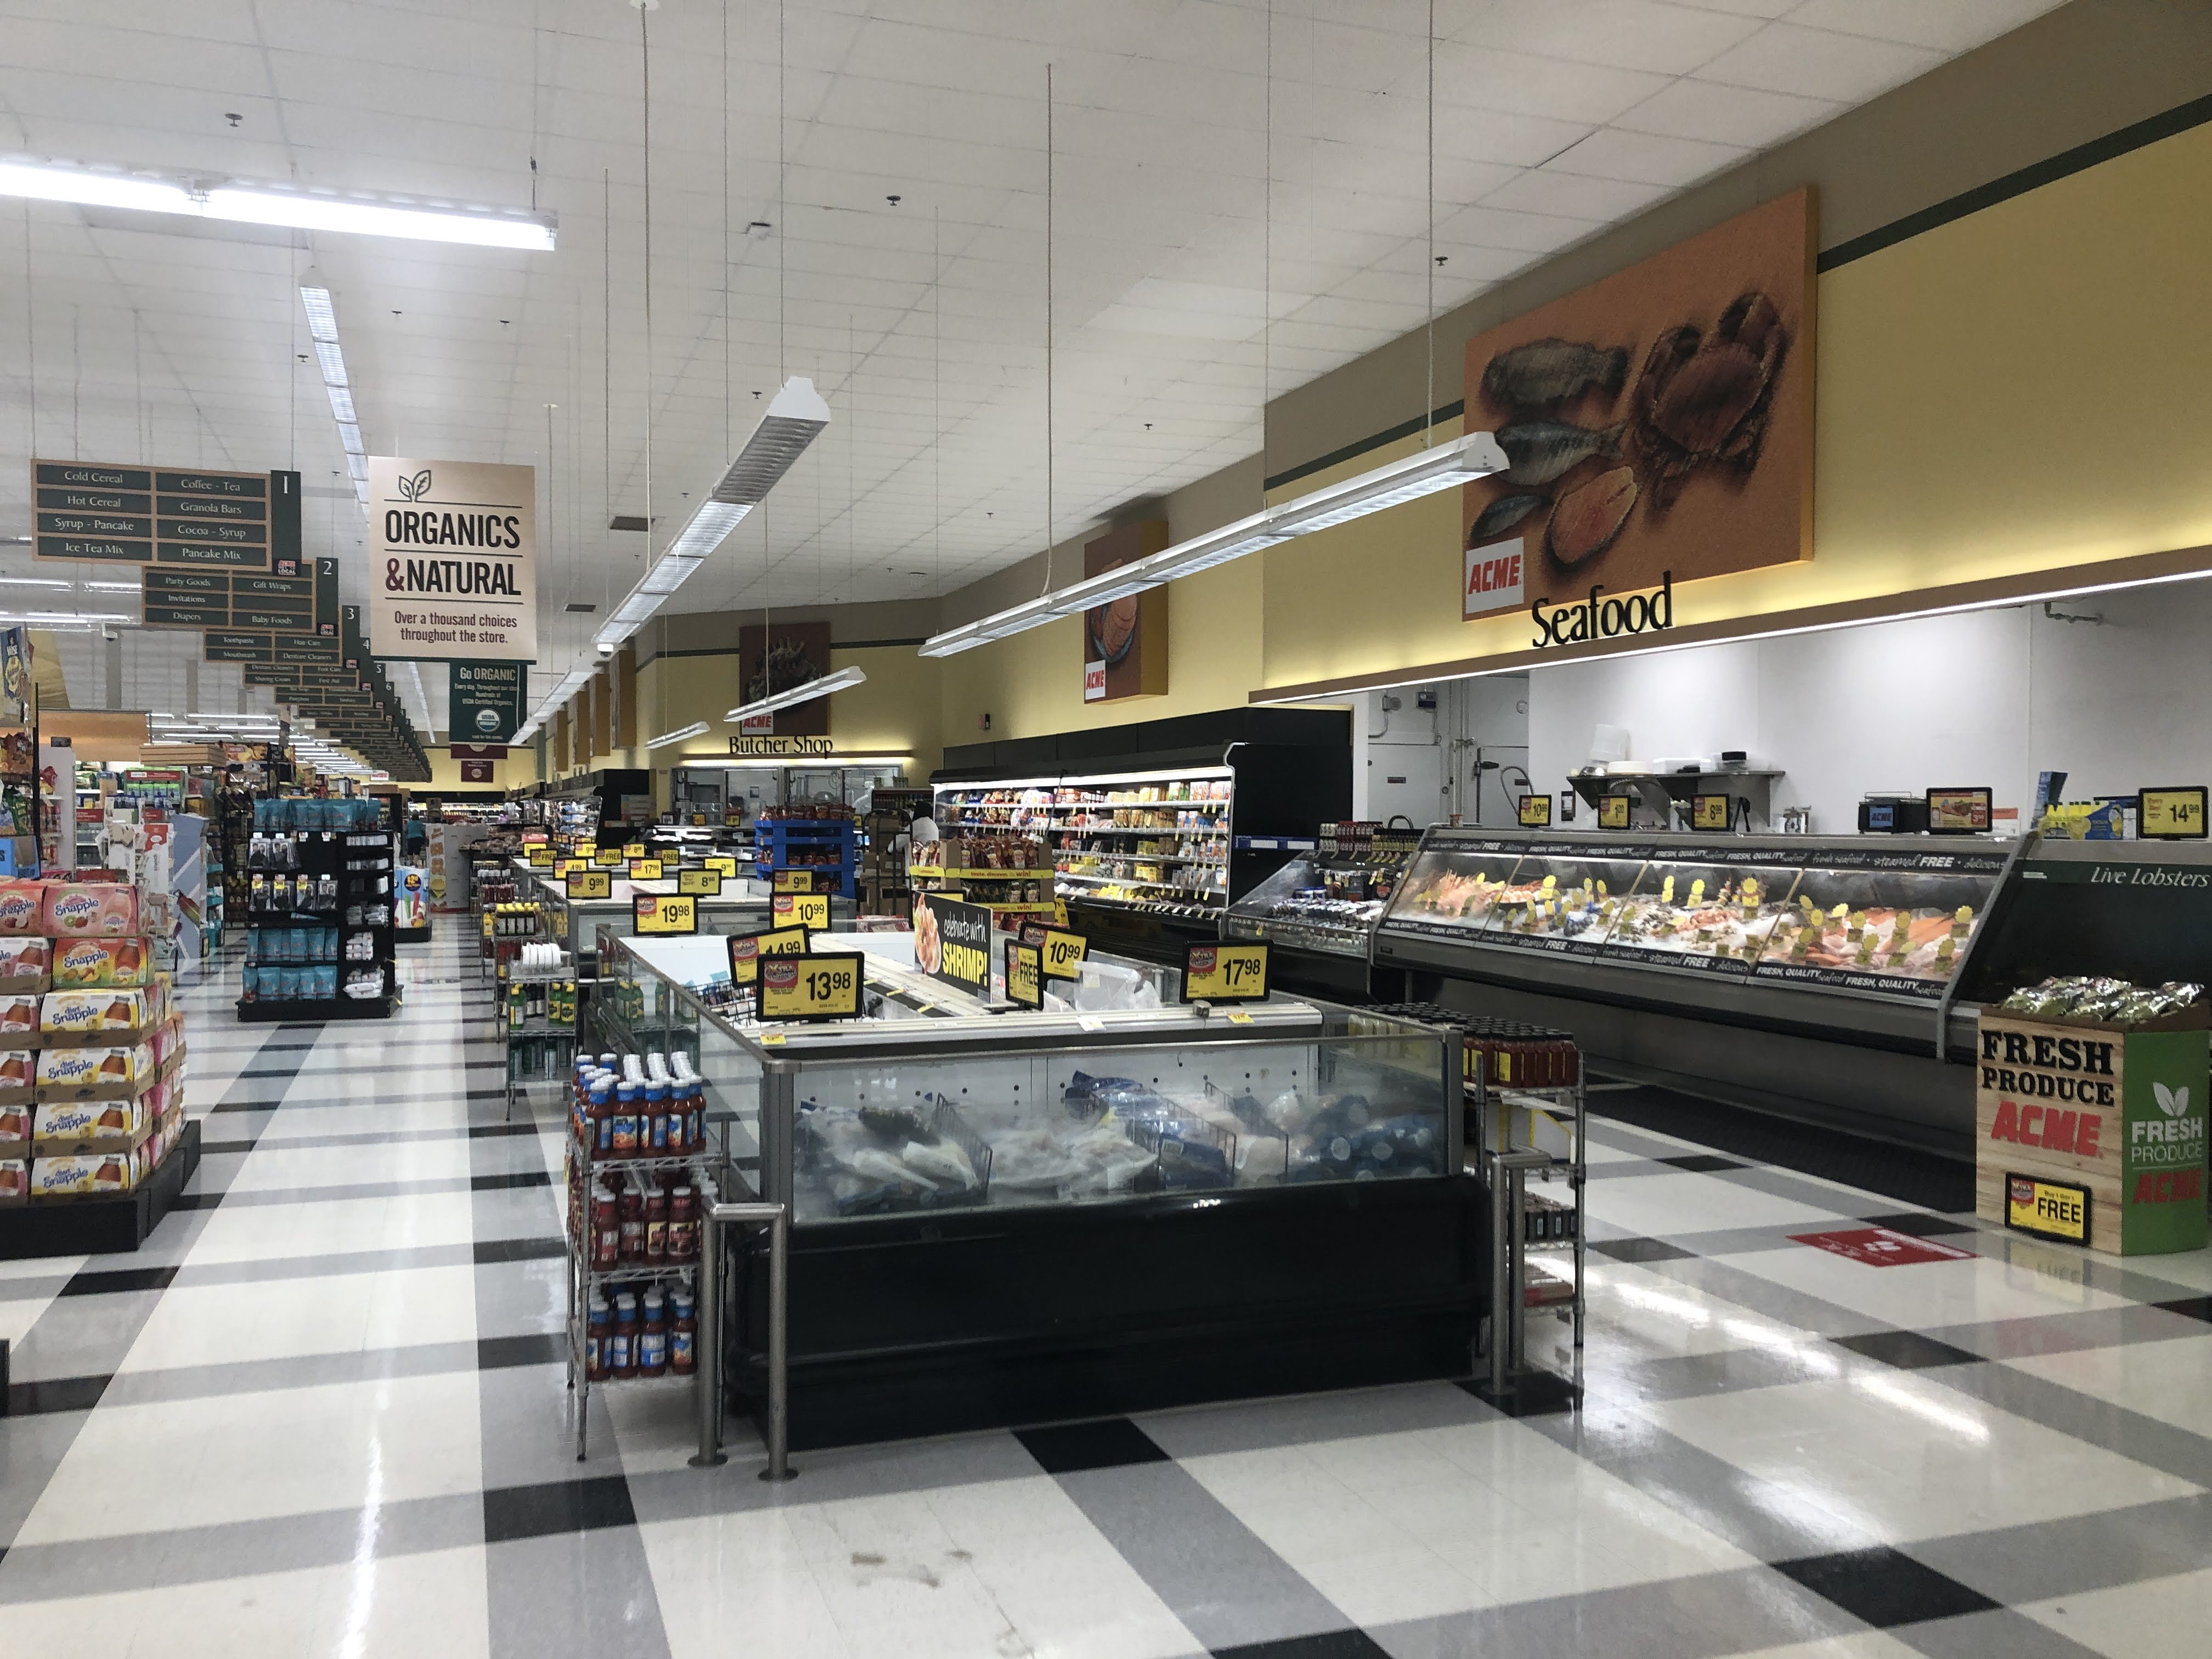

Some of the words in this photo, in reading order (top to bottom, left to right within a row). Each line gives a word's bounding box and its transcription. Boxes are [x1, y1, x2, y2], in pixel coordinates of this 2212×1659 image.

[65, 471, 88, 481] Cold
[92, 472, 123, 483] Cereal
[181, 479, 212, 489] Coffee
[223, 482, 240, 491] Tea
[284, 476, 288, 494] 1
[67, 495, 86, 505] Hot
[89, 496, 121, 507] Cereal
[180, 502, 218, 513] Granola
[221, 504, 242, 514] Bars
[55, 517, 83, 531] Syrup
[94, 520, 134, 531] Pancake
[178, 525, 208, 535] Cocoa
[219, 527, 246, 539] Syrup
[386, 510, 520, 549] ORGANICS
[66, 543, 80, 552] Ice
[83, 543, 101, 554] Tea
[105, 545, 123, 554] Mix
[182, 548, 220, 558] Pancake
[224, 550, 241, 560] Mix
[323, 561, 332, 574] 2
[1468, 554, 1521, 595] ACME
[166, 578, 184, 587] Party
[187, 577, 211, 586] Goods
[269, 582, 291, 591] Wraps
[168, 595, 206, 603] Invitations
[173, 612, 201, 621] Diapers
[348, 608, 354, 620] 3
[1532, 570, 1673, 647] Seafood
[252, 616, 268, 625] Baby
[394, 611, 417, 624] Over
[420, 614, 426, 624] a
[430, 612, 476, 626] thousand
[479, 614, 517, 628] choices
[400, 628, 456, 643] throughout
[460, 630, 476, 642] the
[479, 631, 508, 643] store.
[363, 639, 369, 650] 4
[376, 664, 381, 674] 5
[460, 667, 472, 680] Go
[474, 668, 516, 681] ORGANIC
[1086, 669, 1104, 690] ACME
[743, 716, 771, 728] ACME
[729, 736, 788, 754] Butcher
[794, 736, 833, 759] Shop
[644, 865, 659, 874] 1799
[1920, 857, 1954, 867] FREE
[589, 878, 604, 890] 999
[794, 877, 808, 889] 999
[2091, 866, 2126, 884] Live
[2131, 867, 2211, 887] Lobsters
[55, 898, 99, 917] Snapple
[662, 905, 690, 923] 1998
[798, 904, 824, 921] 1099
[944, 911, 970, 940] celebrate
[970, 913, 986, 943] with
[64, 950, 108, 968] Snapple
[1051, 940, 1080, 964] 1099
[943, 941, 988, 986] SHRIMP!
[1683, 956, 1711, 967] FREE
[1020, 961, 1038, 986] FREE
[1223, 958, 1260, 985] 1798
[1757, 966, 1782, 976] FRESH,
[1785, 968, 1821, 978] QUALITY
[1846, 977, 1876, 988] FRESH,
[1878, 979, 1919, 990] QUALITY
[806, 972, 850, 1001] 1398
[53, 1005, 98, 1025] Snapple
[1981, 1030, 2114, 1075] FRESH
[48, 1060, 94, 1079] Snapple
[1982, 1066, 2114, 1107] PRODUCE
[46, 1114, 91, 1133] Snapple
[58, 1114, 74, 1122] diet
[1991, 1101, 2103, 1158] ACME
[2132, 1117, 2203, 1143] FRESH
[2131, 1141, 2203, 1163] PRODUCE
[43, 1167, 88, 1189] Snapple
[2133, 1169, 2203, 1204] ACME
[2038, 1197, 2081, 1223] FREE
